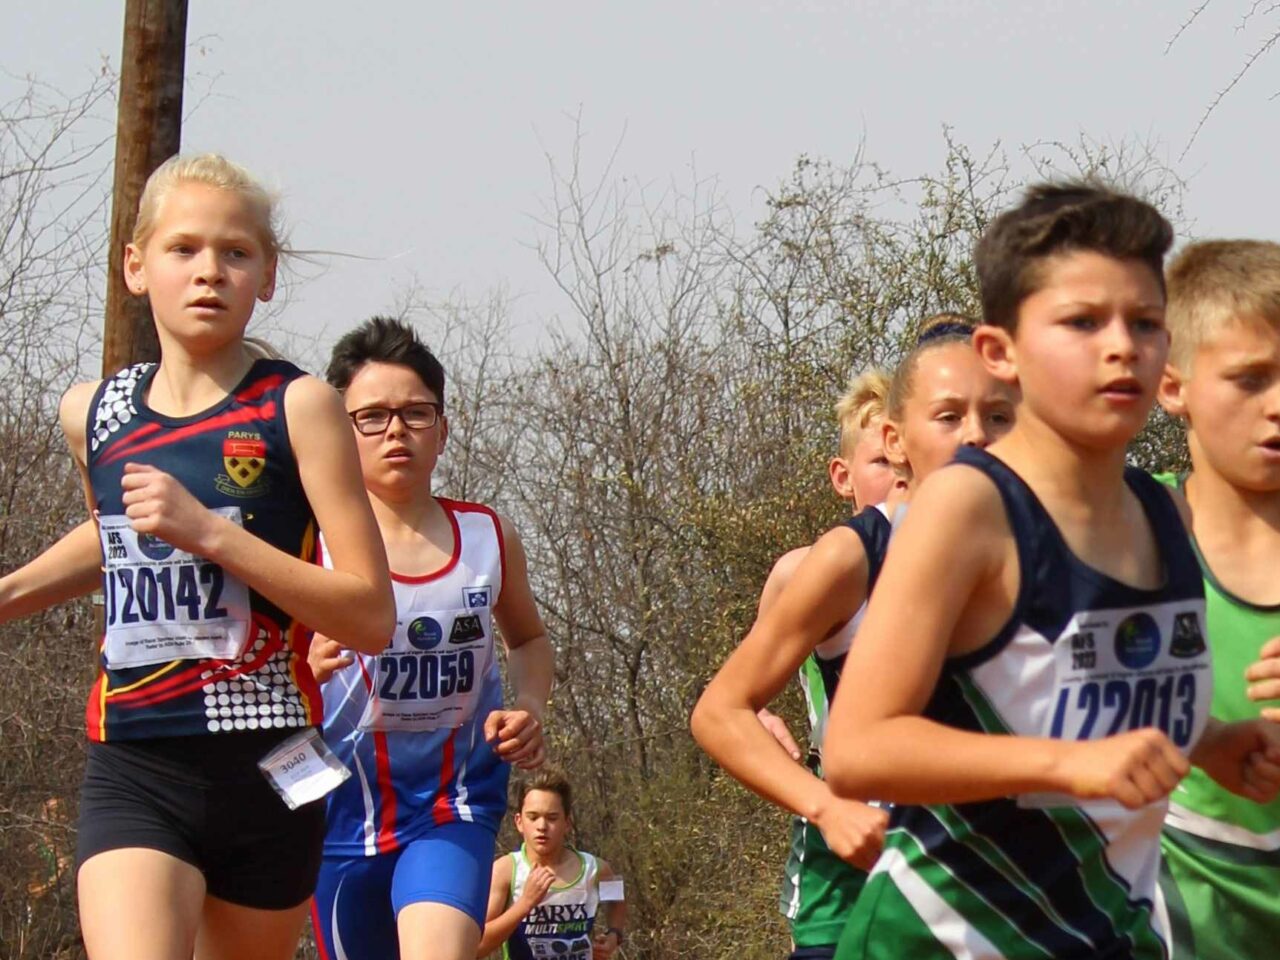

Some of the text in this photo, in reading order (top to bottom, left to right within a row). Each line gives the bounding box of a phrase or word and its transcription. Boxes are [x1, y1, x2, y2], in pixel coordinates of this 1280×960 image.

[227, 430, 262, 441] PARYS
[379, 650, 475, 700] 22059
[279, 752, 307, 774] 3040
